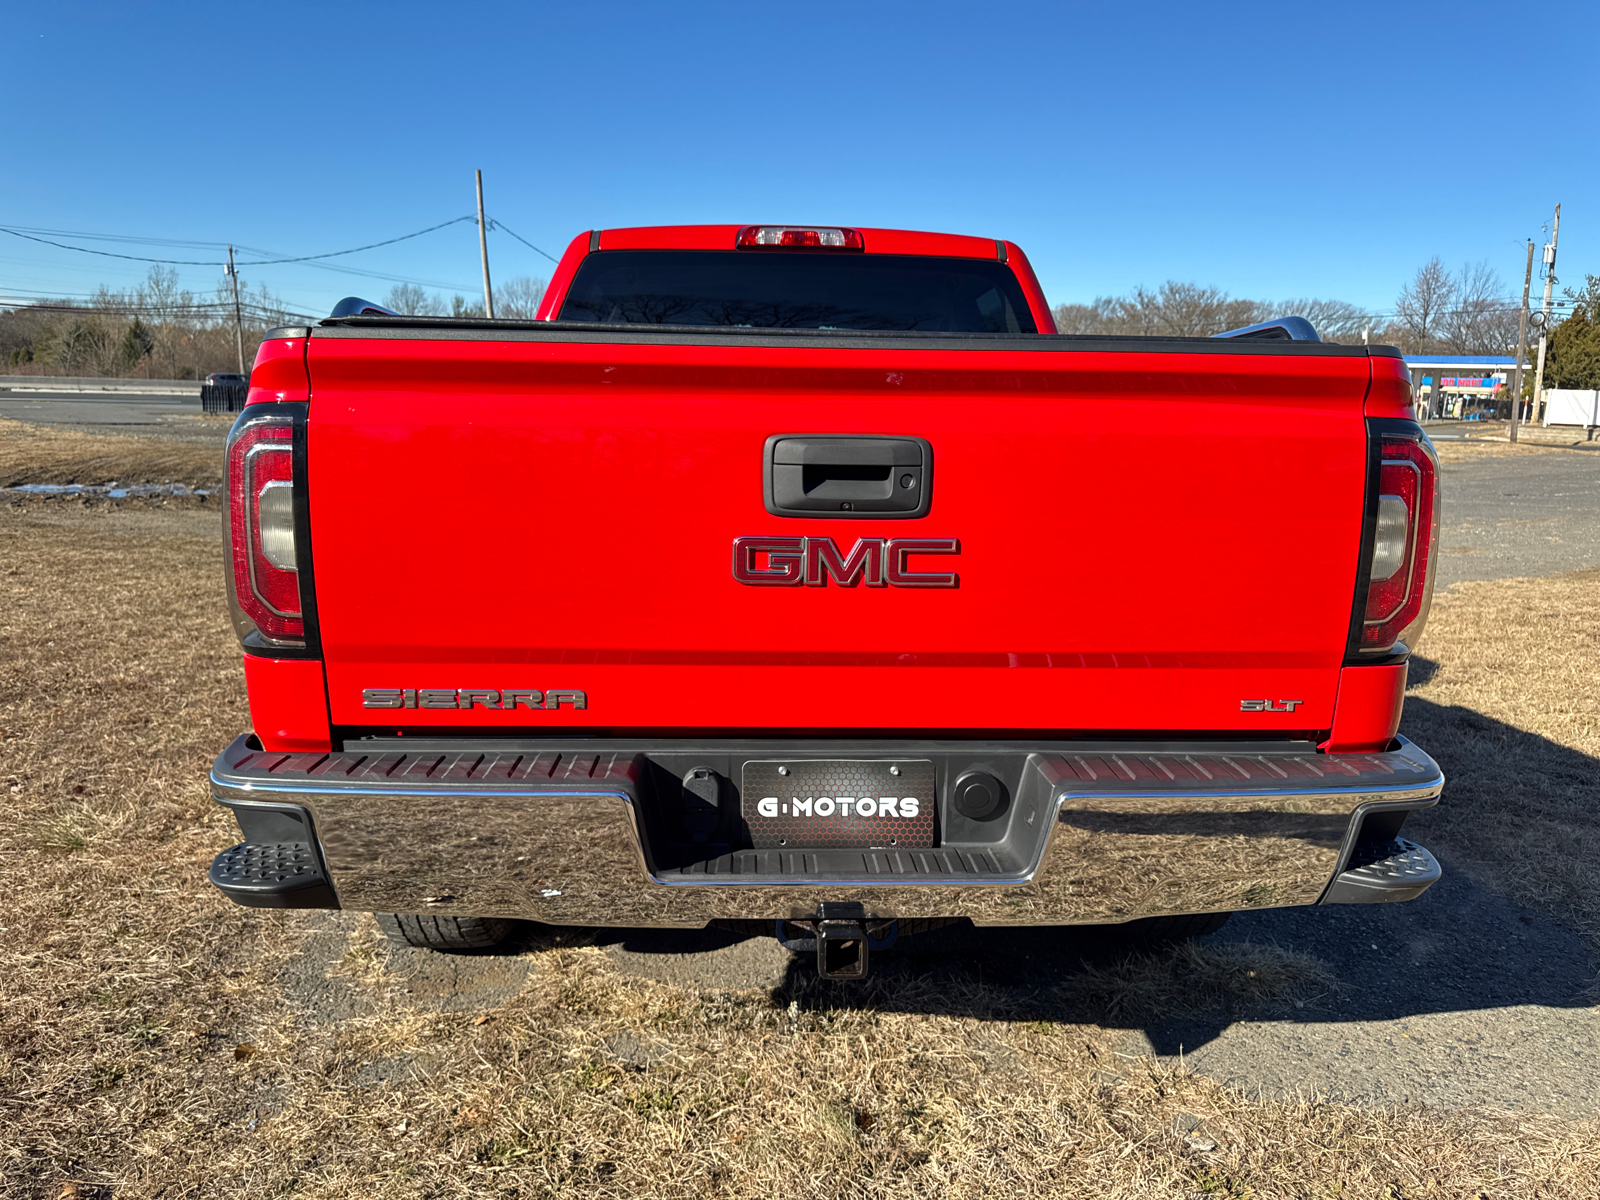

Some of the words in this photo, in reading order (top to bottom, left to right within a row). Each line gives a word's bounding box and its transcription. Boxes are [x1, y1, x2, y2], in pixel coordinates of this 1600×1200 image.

[1457, 378, 1483, 387] MART
[732, 536, 958, 586] GMC
[362, 688, 587, 709] SIERRA
[1240, 699, 1303, 712] SLT
